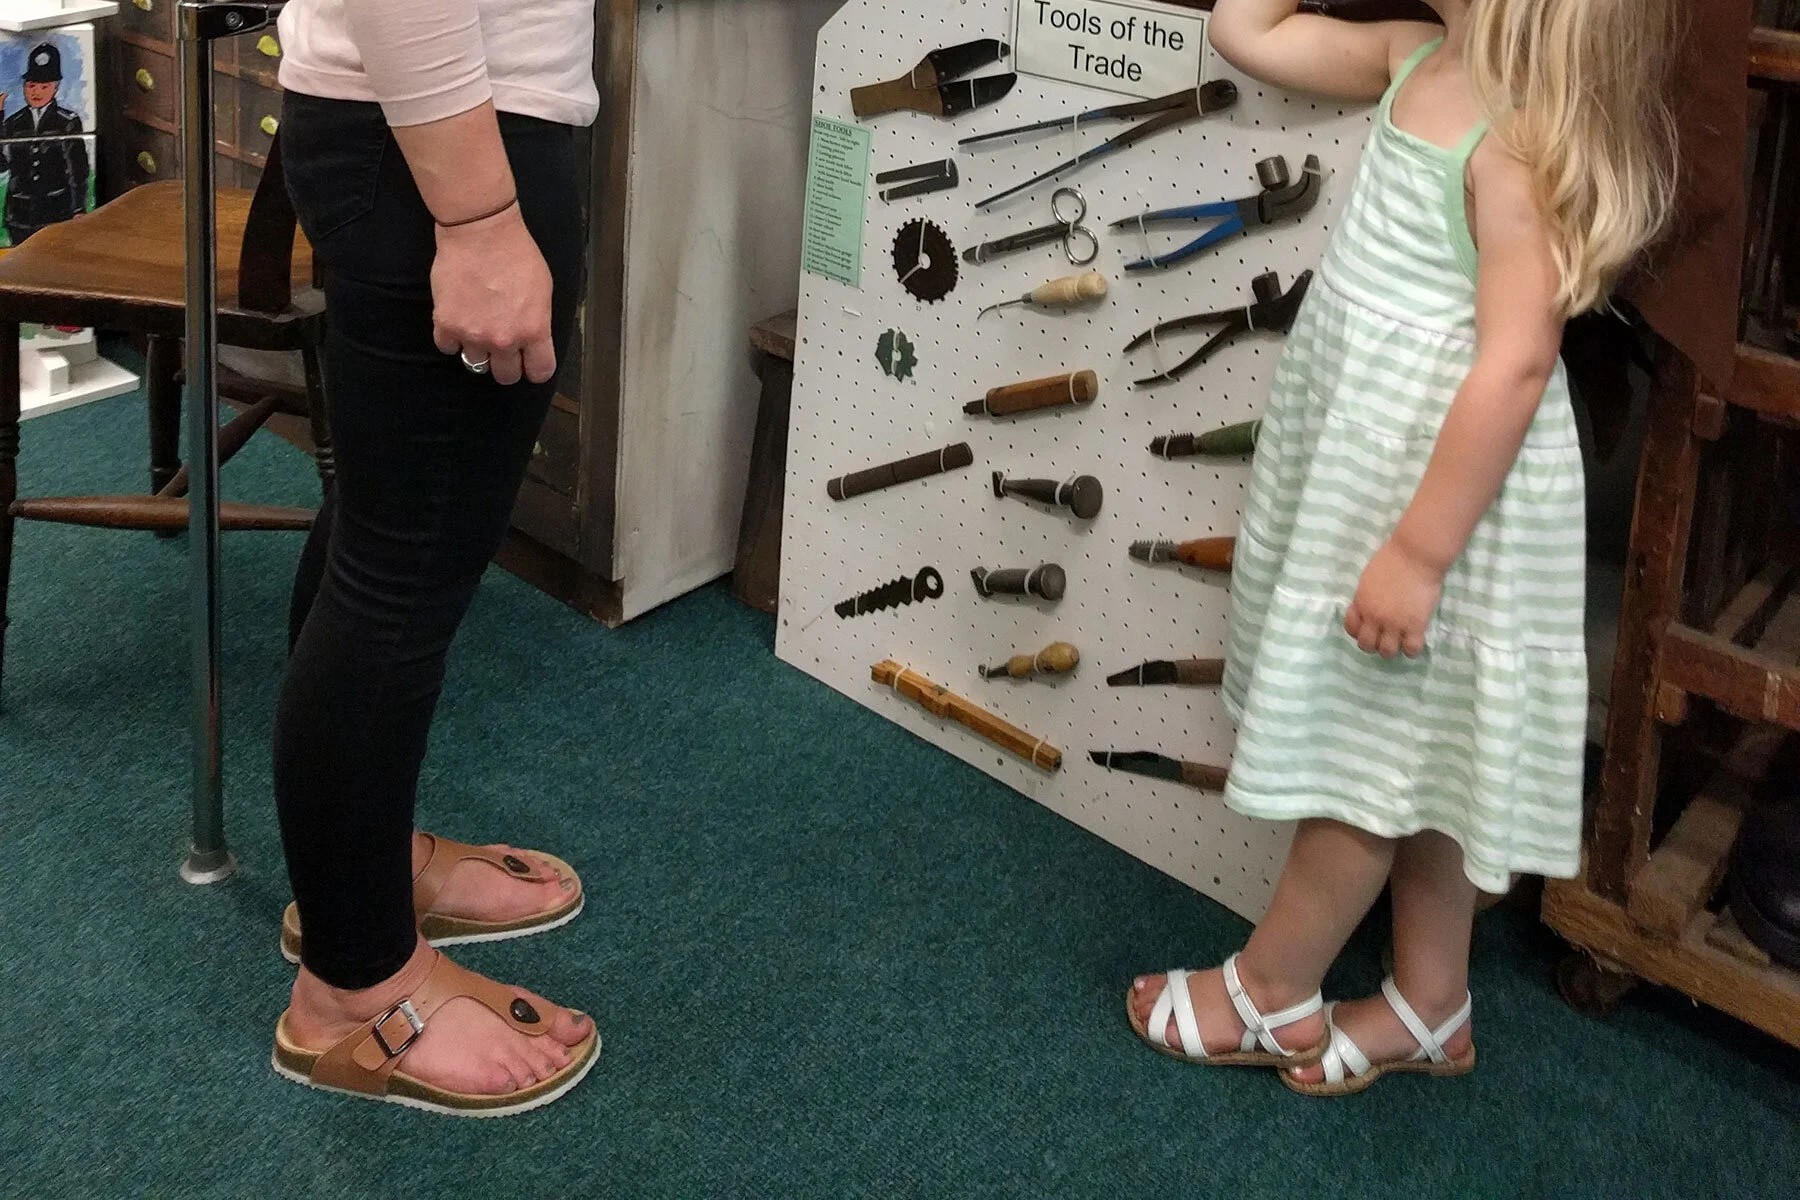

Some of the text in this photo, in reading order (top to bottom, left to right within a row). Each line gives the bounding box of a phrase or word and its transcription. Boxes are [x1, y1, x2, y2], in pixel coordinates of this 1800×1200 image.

[1034, 0, 1184, 51] Tools of the
[1068, 44, 1142, 82] Trade
[832, 124, 853, 137] TOOLS
